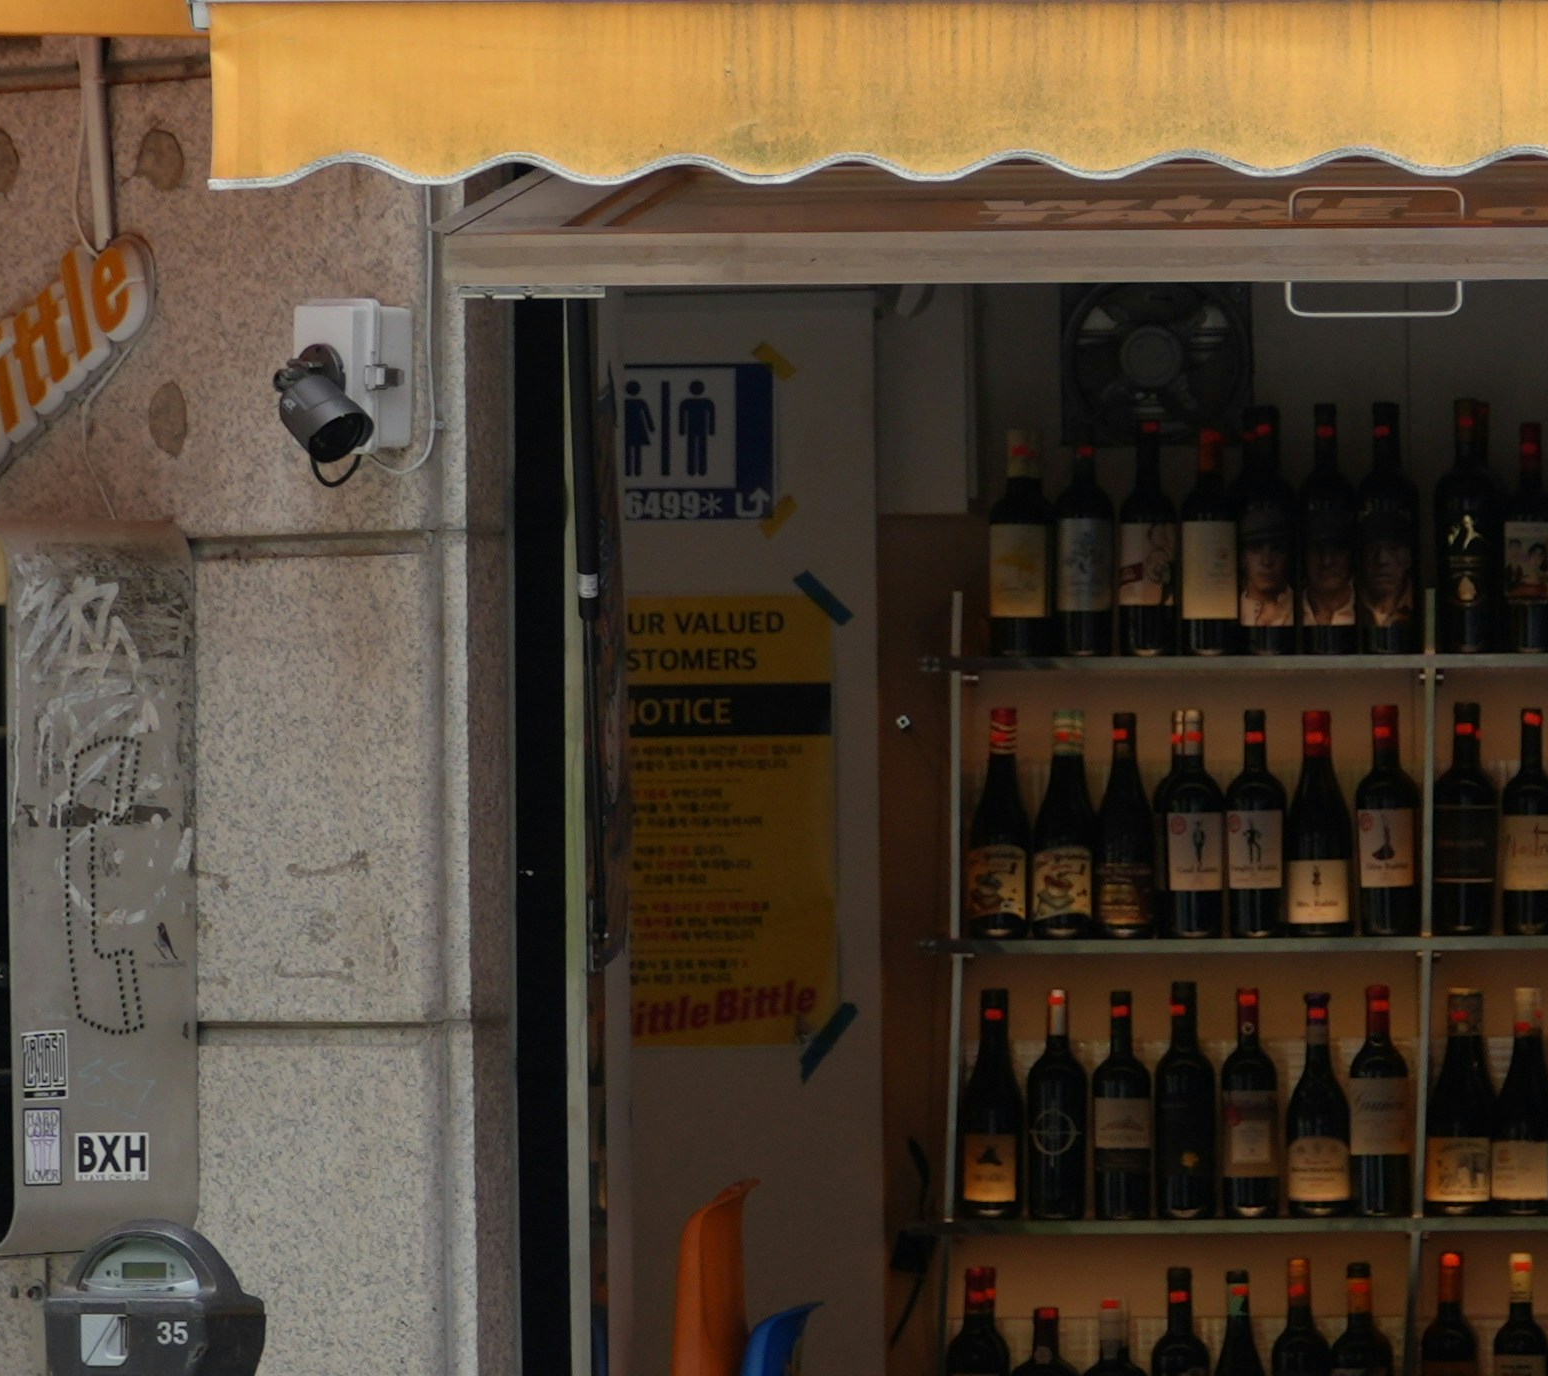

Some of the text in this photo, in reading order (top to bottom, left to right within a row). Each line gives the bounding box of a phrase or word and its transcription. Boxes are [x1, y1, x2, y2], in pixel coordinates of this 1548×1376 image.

[627, 610, 785, 636] UR VALUED
[626, 648, 757, 672] STOMERS
[632, 978, 816, 1037] ittleBittle
[78, 1135, 146, 1172] BXH
[157, 1321, 189, 1344] 35
